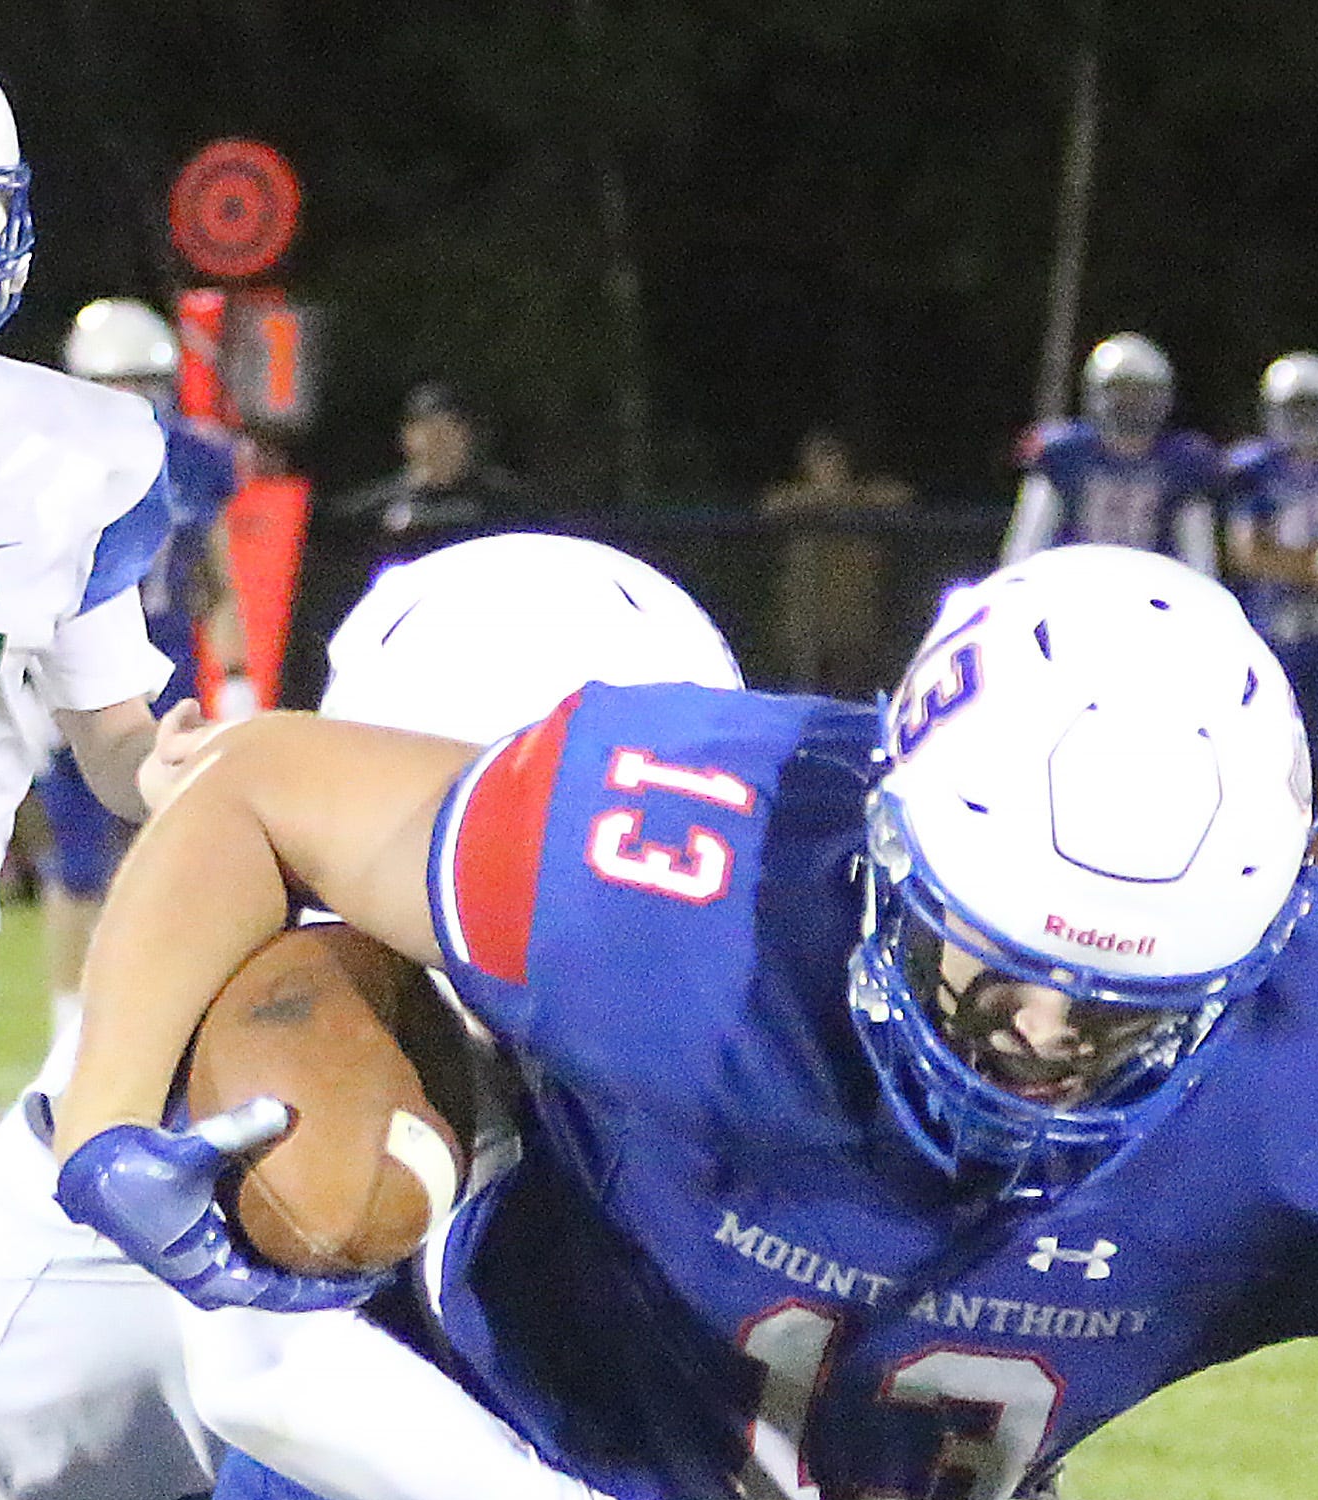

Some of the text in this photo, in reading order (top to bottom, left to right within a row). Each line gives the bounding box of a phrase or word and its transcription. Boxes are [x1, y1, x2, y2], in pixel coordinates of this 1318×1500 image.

[585, 746, 758, 907] 13
[1044, 913, 1157, 957] Riddell
[714, 1211, 1151, 1339] MOUNT ANTHONY
